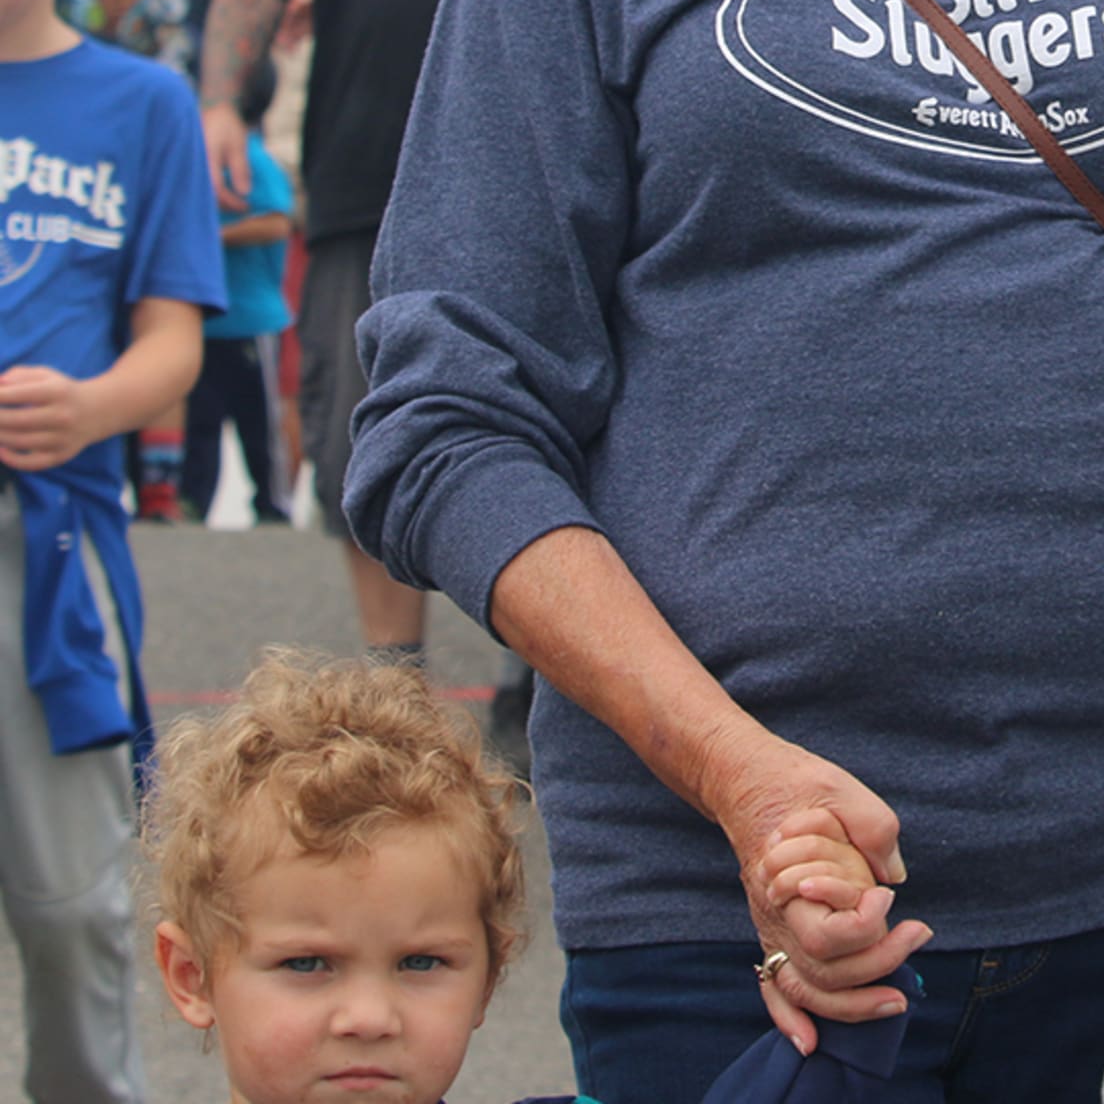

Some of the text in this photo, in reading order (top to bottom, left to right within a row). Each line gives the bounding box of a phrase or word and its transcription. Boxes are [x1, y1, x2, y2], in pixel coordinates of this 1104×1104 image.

[911, 96, 1090, 140] Everett ASox
[7, 212, 72, 243] CLUB
